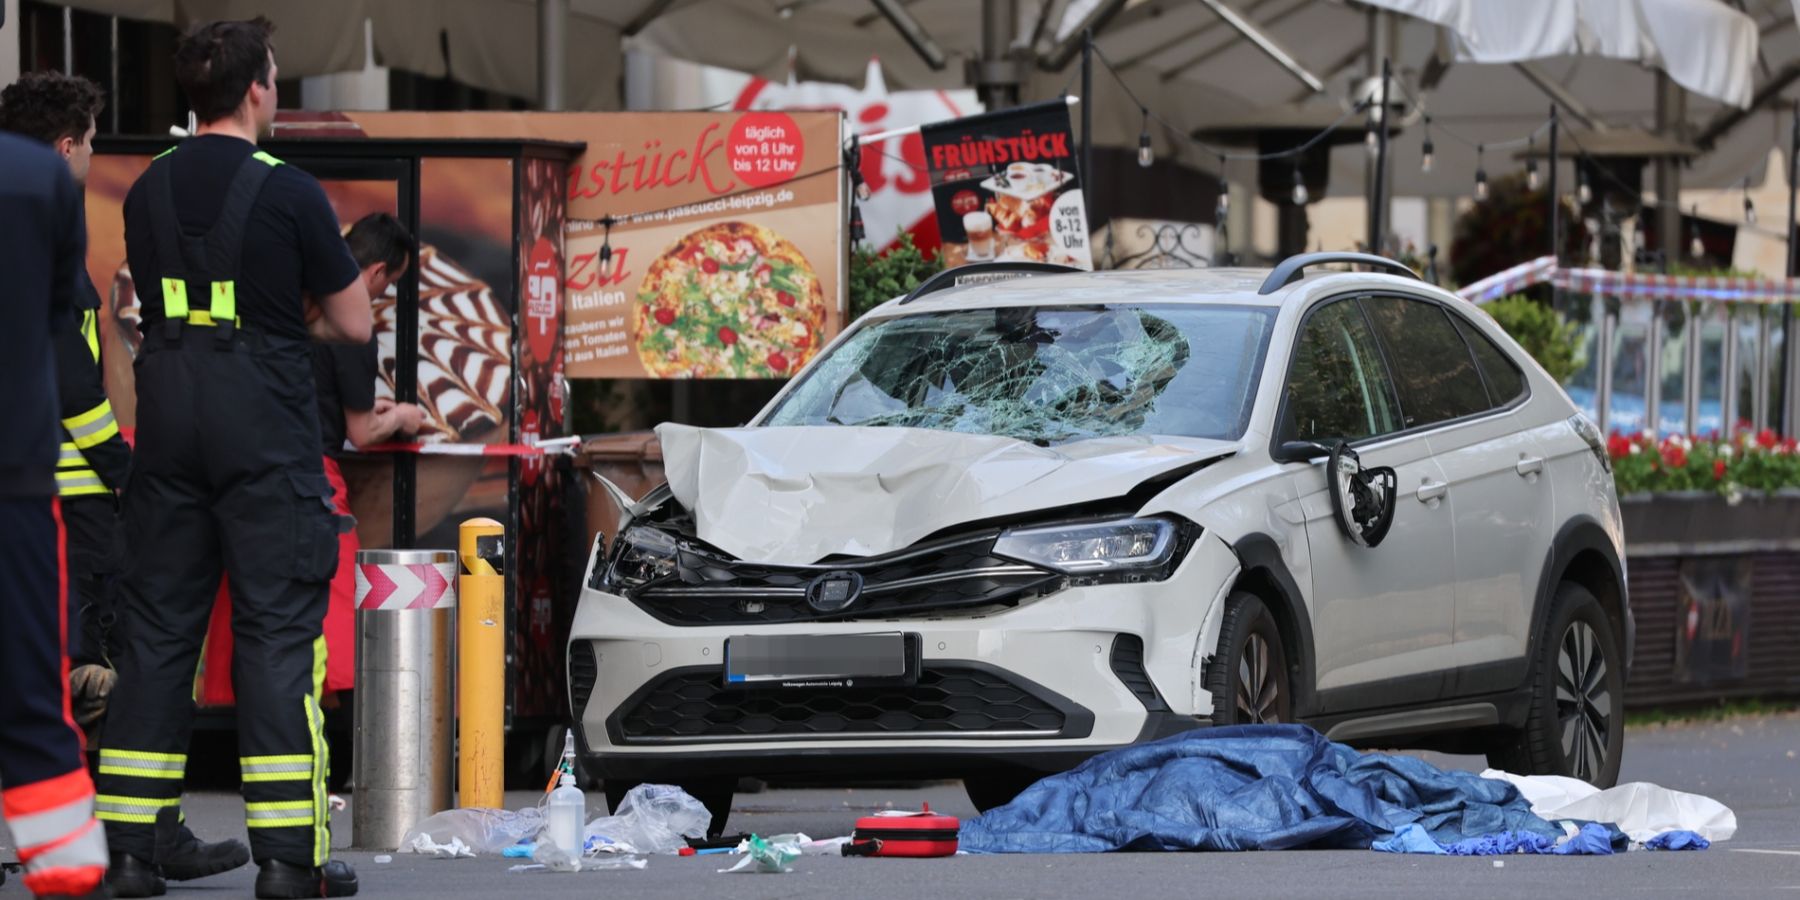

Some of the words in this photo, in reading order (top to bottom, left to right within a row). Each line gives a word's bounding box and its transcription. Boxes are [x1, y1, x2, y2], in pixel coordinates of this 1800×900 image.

[745, 126, 785, 141] täglich
[735, 144, 758, 155] von
[760, 142, 769, 155] 8
[772, 142, 795, 155] Uhr
[932, 129, 1070, 170] FRÜHSTÜCK
[733, 158, 752, 171] bis
[756, 158, 771, 171] 12
[773, 158, 797, 171] Uhr
[632, 188, 795, 223] www.pascucci-leipzig.de
[1059, 206, 1079, 216] von
[1055, 218, 1081, 232] 8-12
[1063, 235, 1083, 248] Uhr
[572, 289, 625, 310] Italien
[608, 315, 624, 328] wir
[582, 331, 627, 346] Tomaten
[575, 350, 593, 362] aus
[595, 345, 629, 358] Italien
